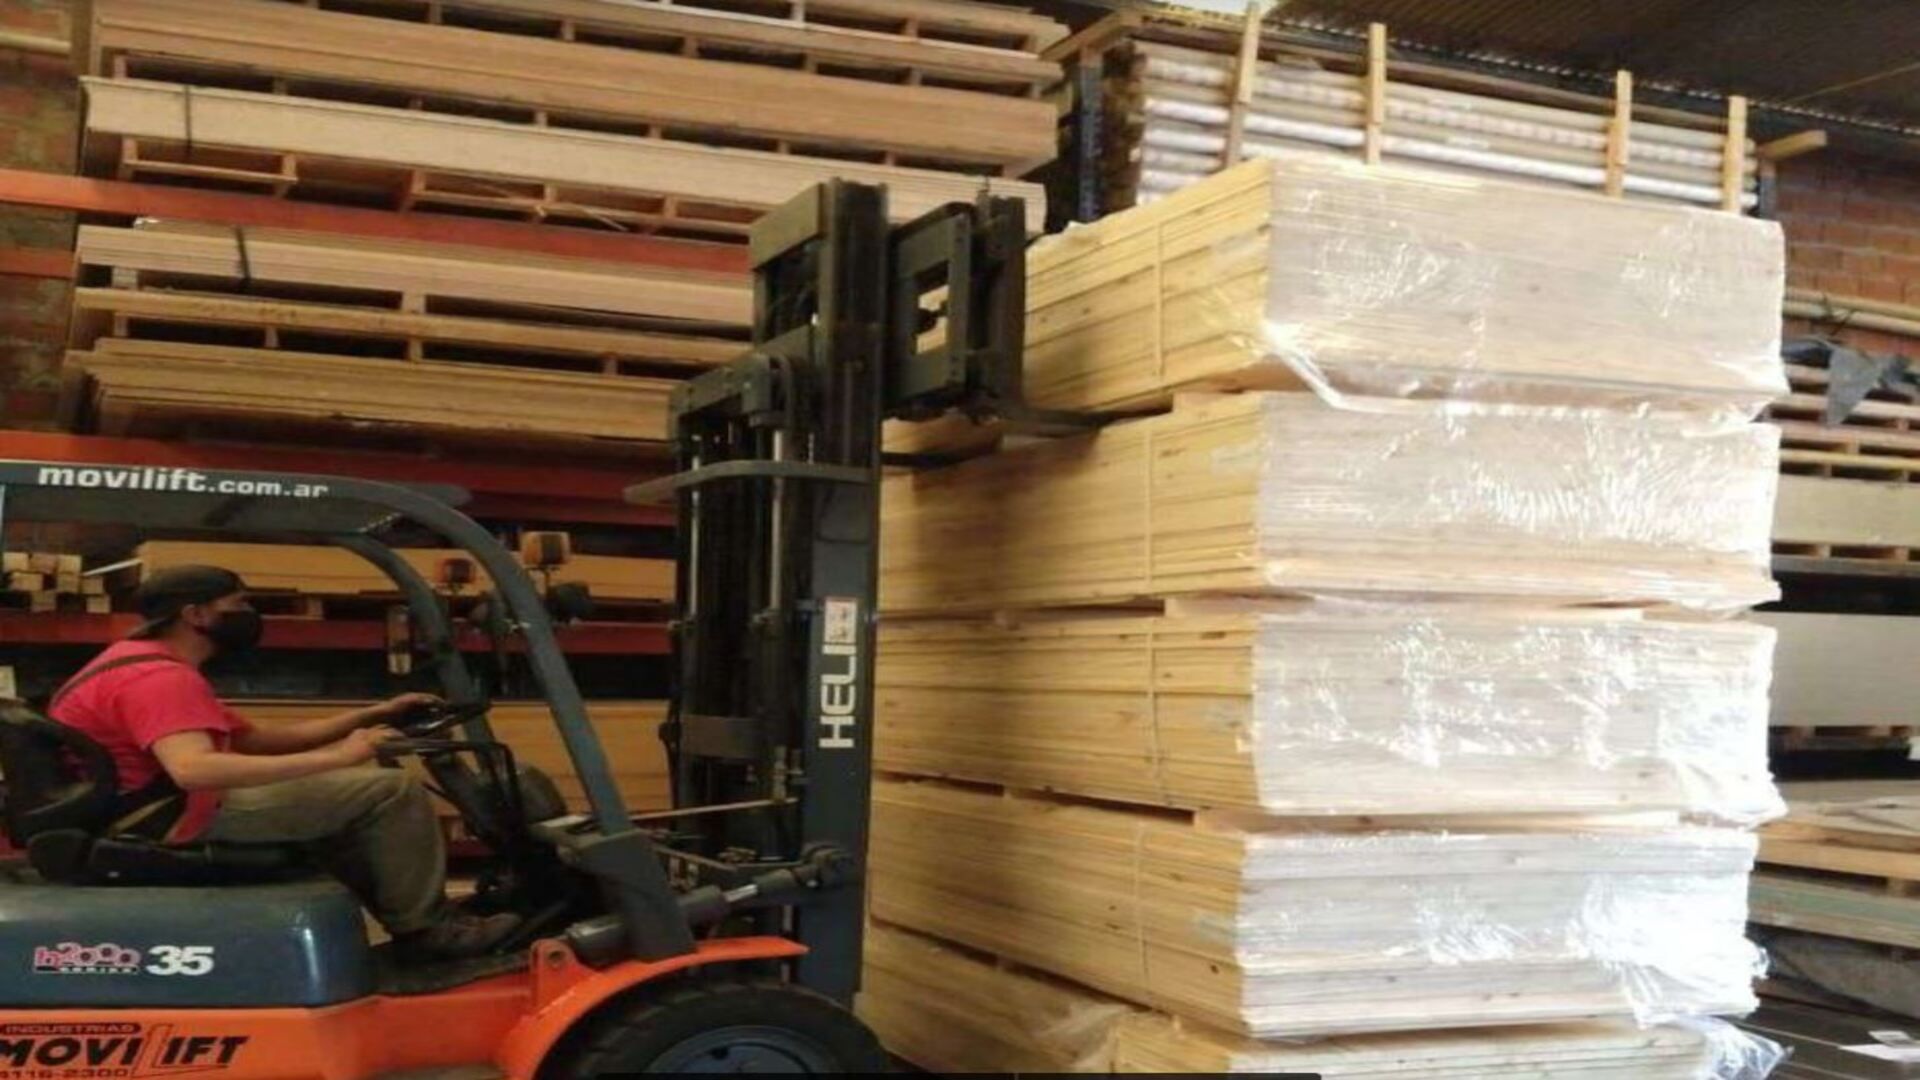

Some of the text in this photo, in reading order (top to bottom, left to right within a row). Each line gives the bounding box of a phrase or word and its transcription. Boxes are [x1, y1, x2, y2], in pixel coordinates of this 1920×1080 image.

[38, 466, 328, 498] movilift.com.ar
[819, 644, 857, 748] HELI
[146, 945, 214, 976] 35
